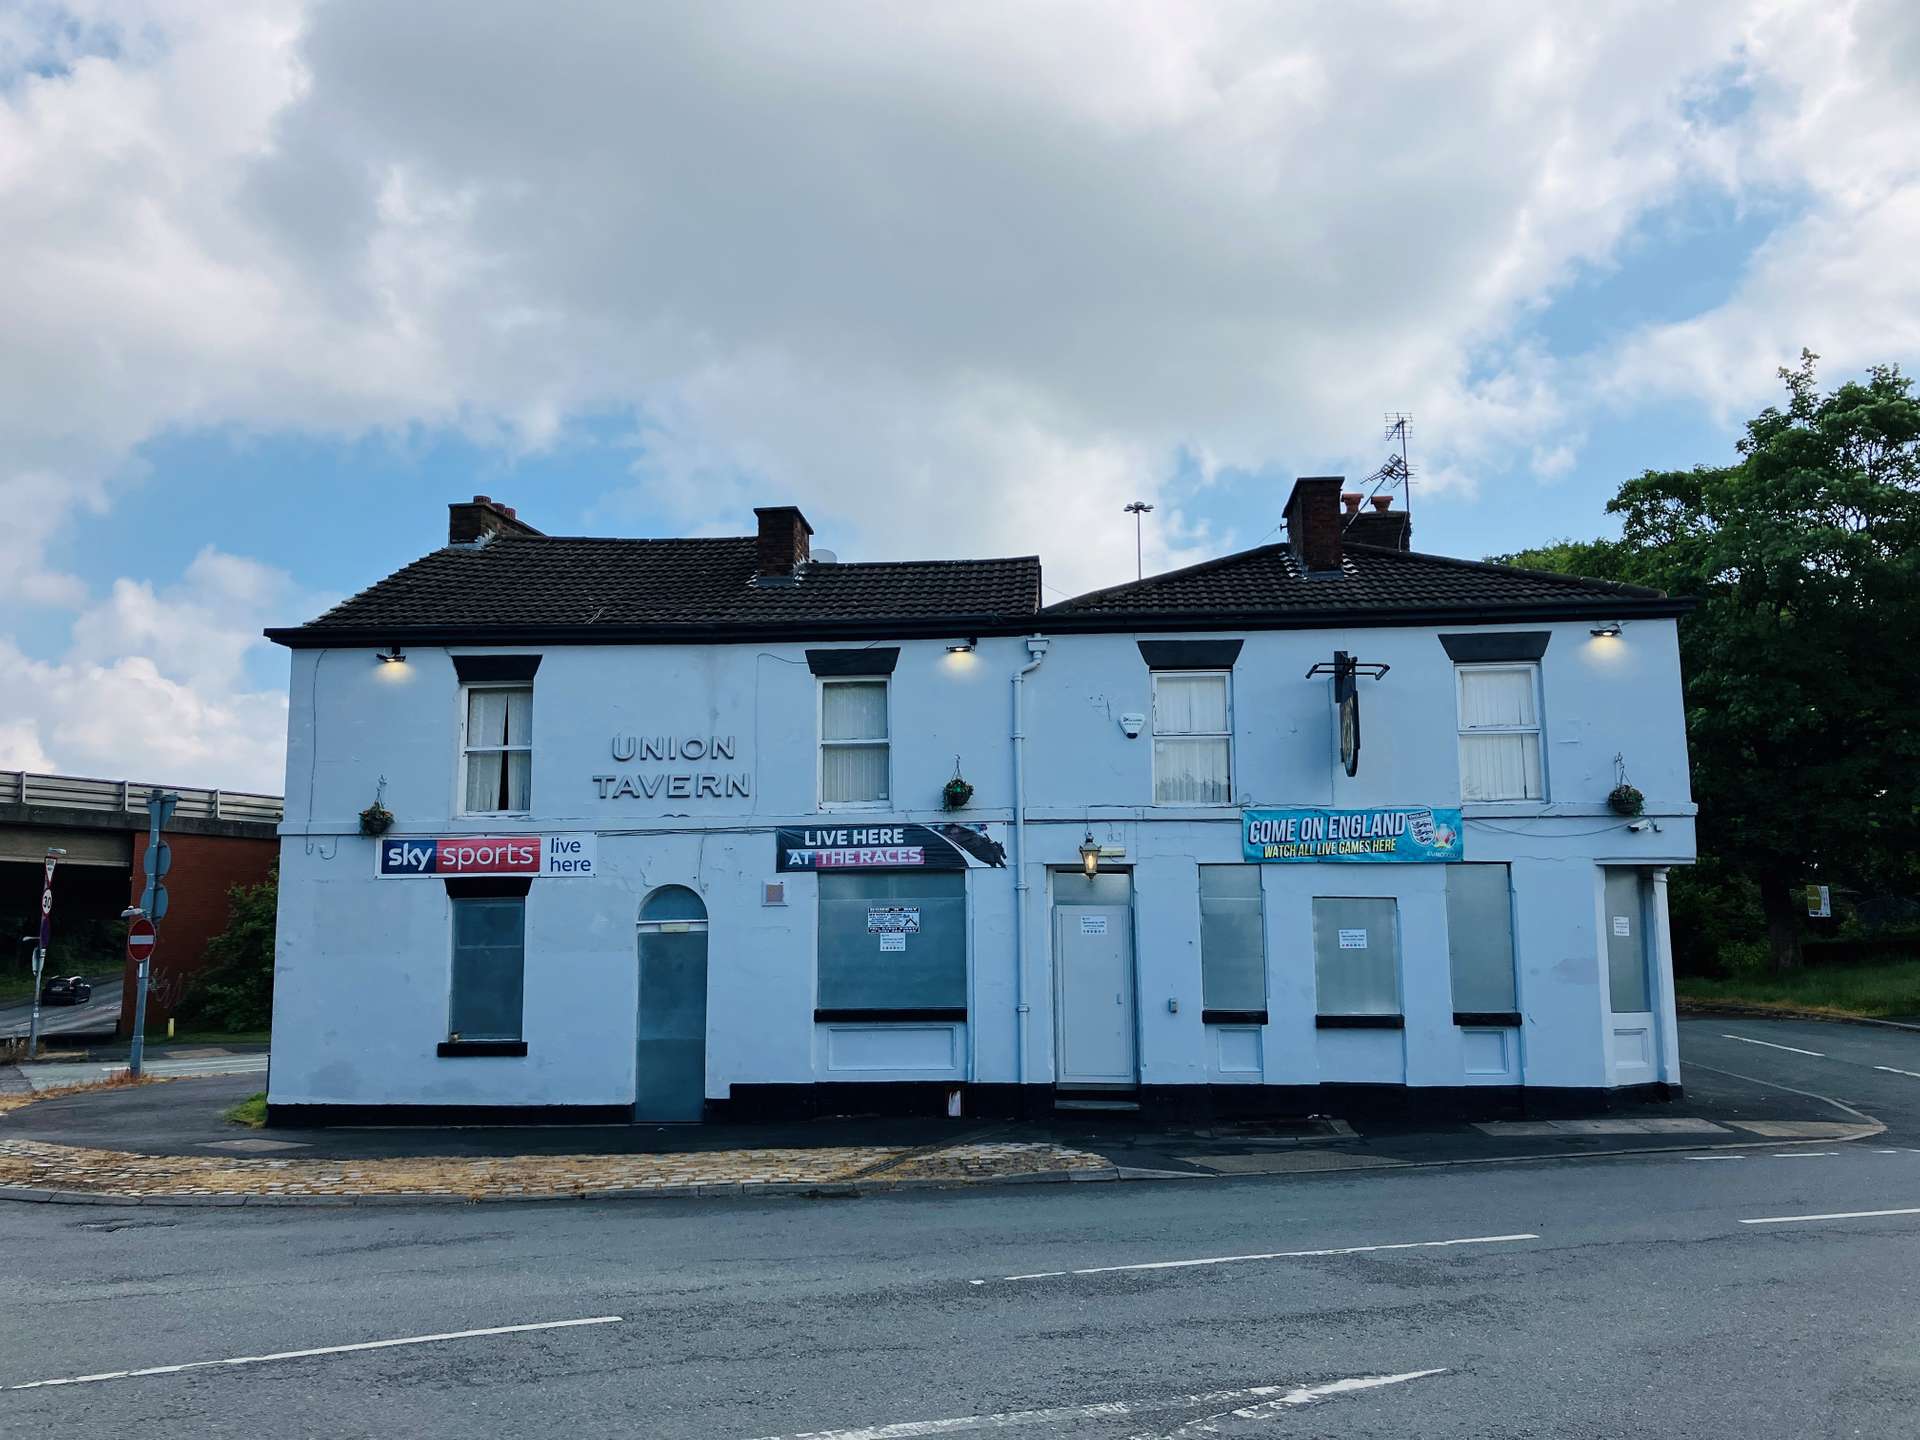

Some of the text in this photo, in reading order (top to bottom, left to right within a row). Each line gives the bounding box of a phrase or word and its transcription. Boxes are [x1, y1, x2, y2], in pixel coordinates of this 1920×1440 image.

[612, 735, 736, 762] UNION
[592, 773, 750, 799] TAVERN
[804, 828, 904, 846] LIVE HERE
[1249, 812, 1406, 844] COME ON ENGLAND
[550, 837, 581, 854] live
[1264, 839, 1396, 858] WATCH ALL LIVE GAMES HERE
[388, 842, 534, 871] sky sports
[550, 856, 592, 872] here
[788, 848, 922, 865] AT THE RACES
